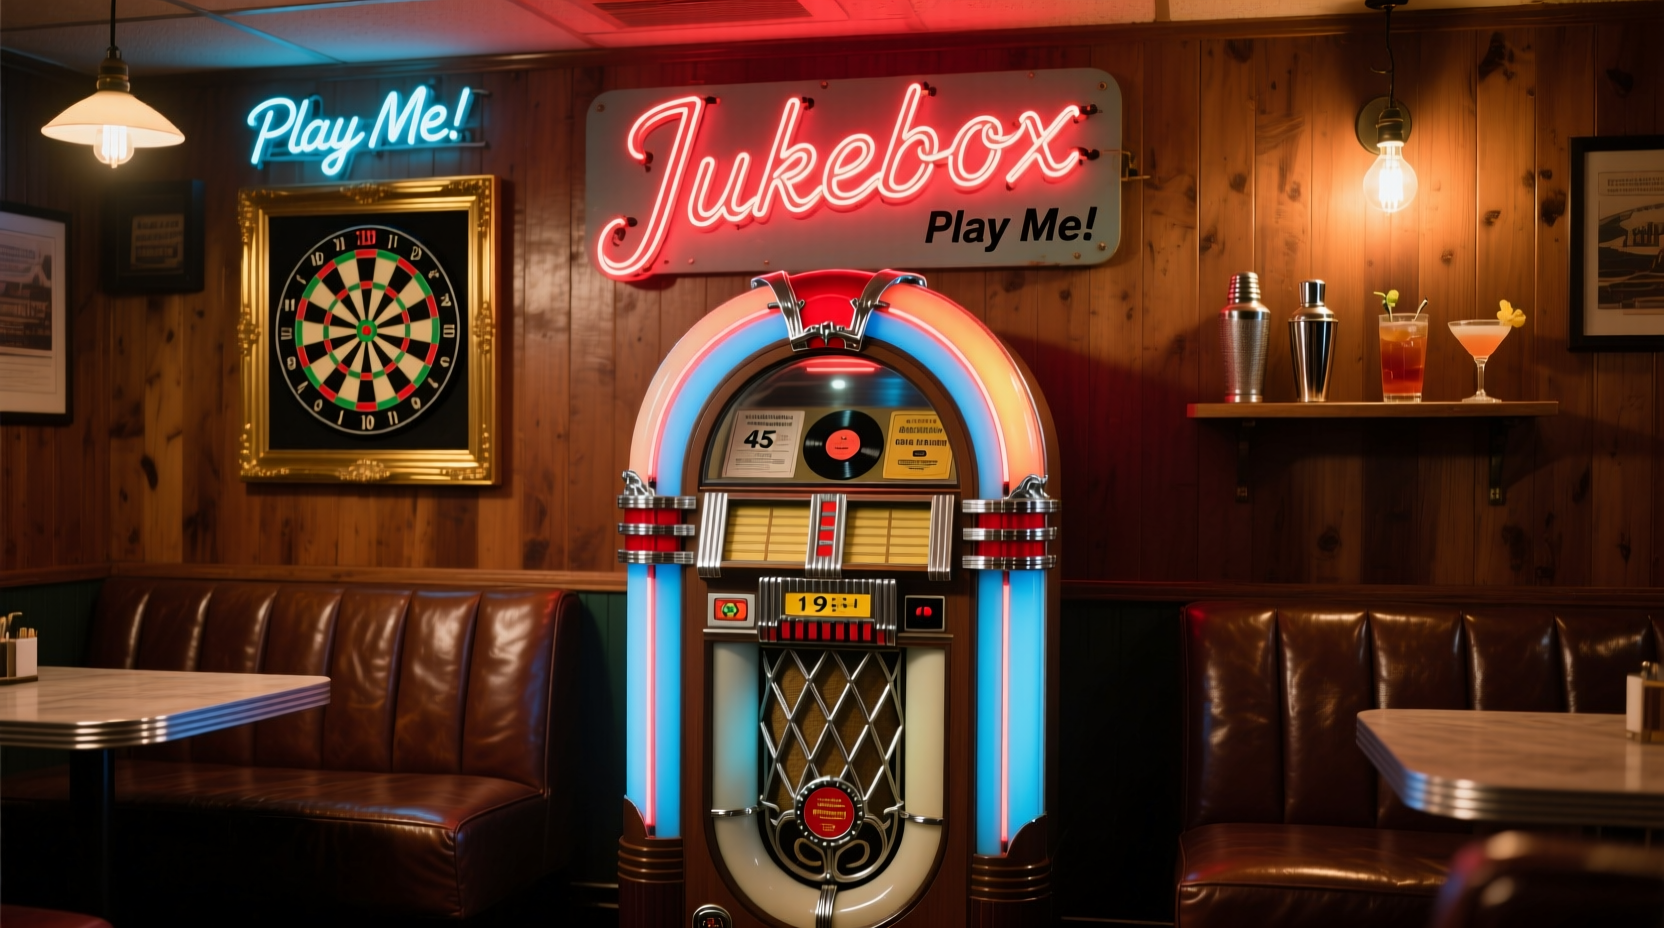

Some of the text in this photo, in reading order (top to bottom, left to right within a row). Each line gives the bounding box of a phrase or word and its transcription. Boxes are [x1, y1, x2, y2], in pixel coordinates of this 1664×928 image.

[246, 84, 472, 176] Play Me!
[596, 83, 1081, 277] Jukebox
[924, 206, 1098, 253] Play Me!
[360, 414, 375, 431] 10
[743, 429, 777, 449] 45
